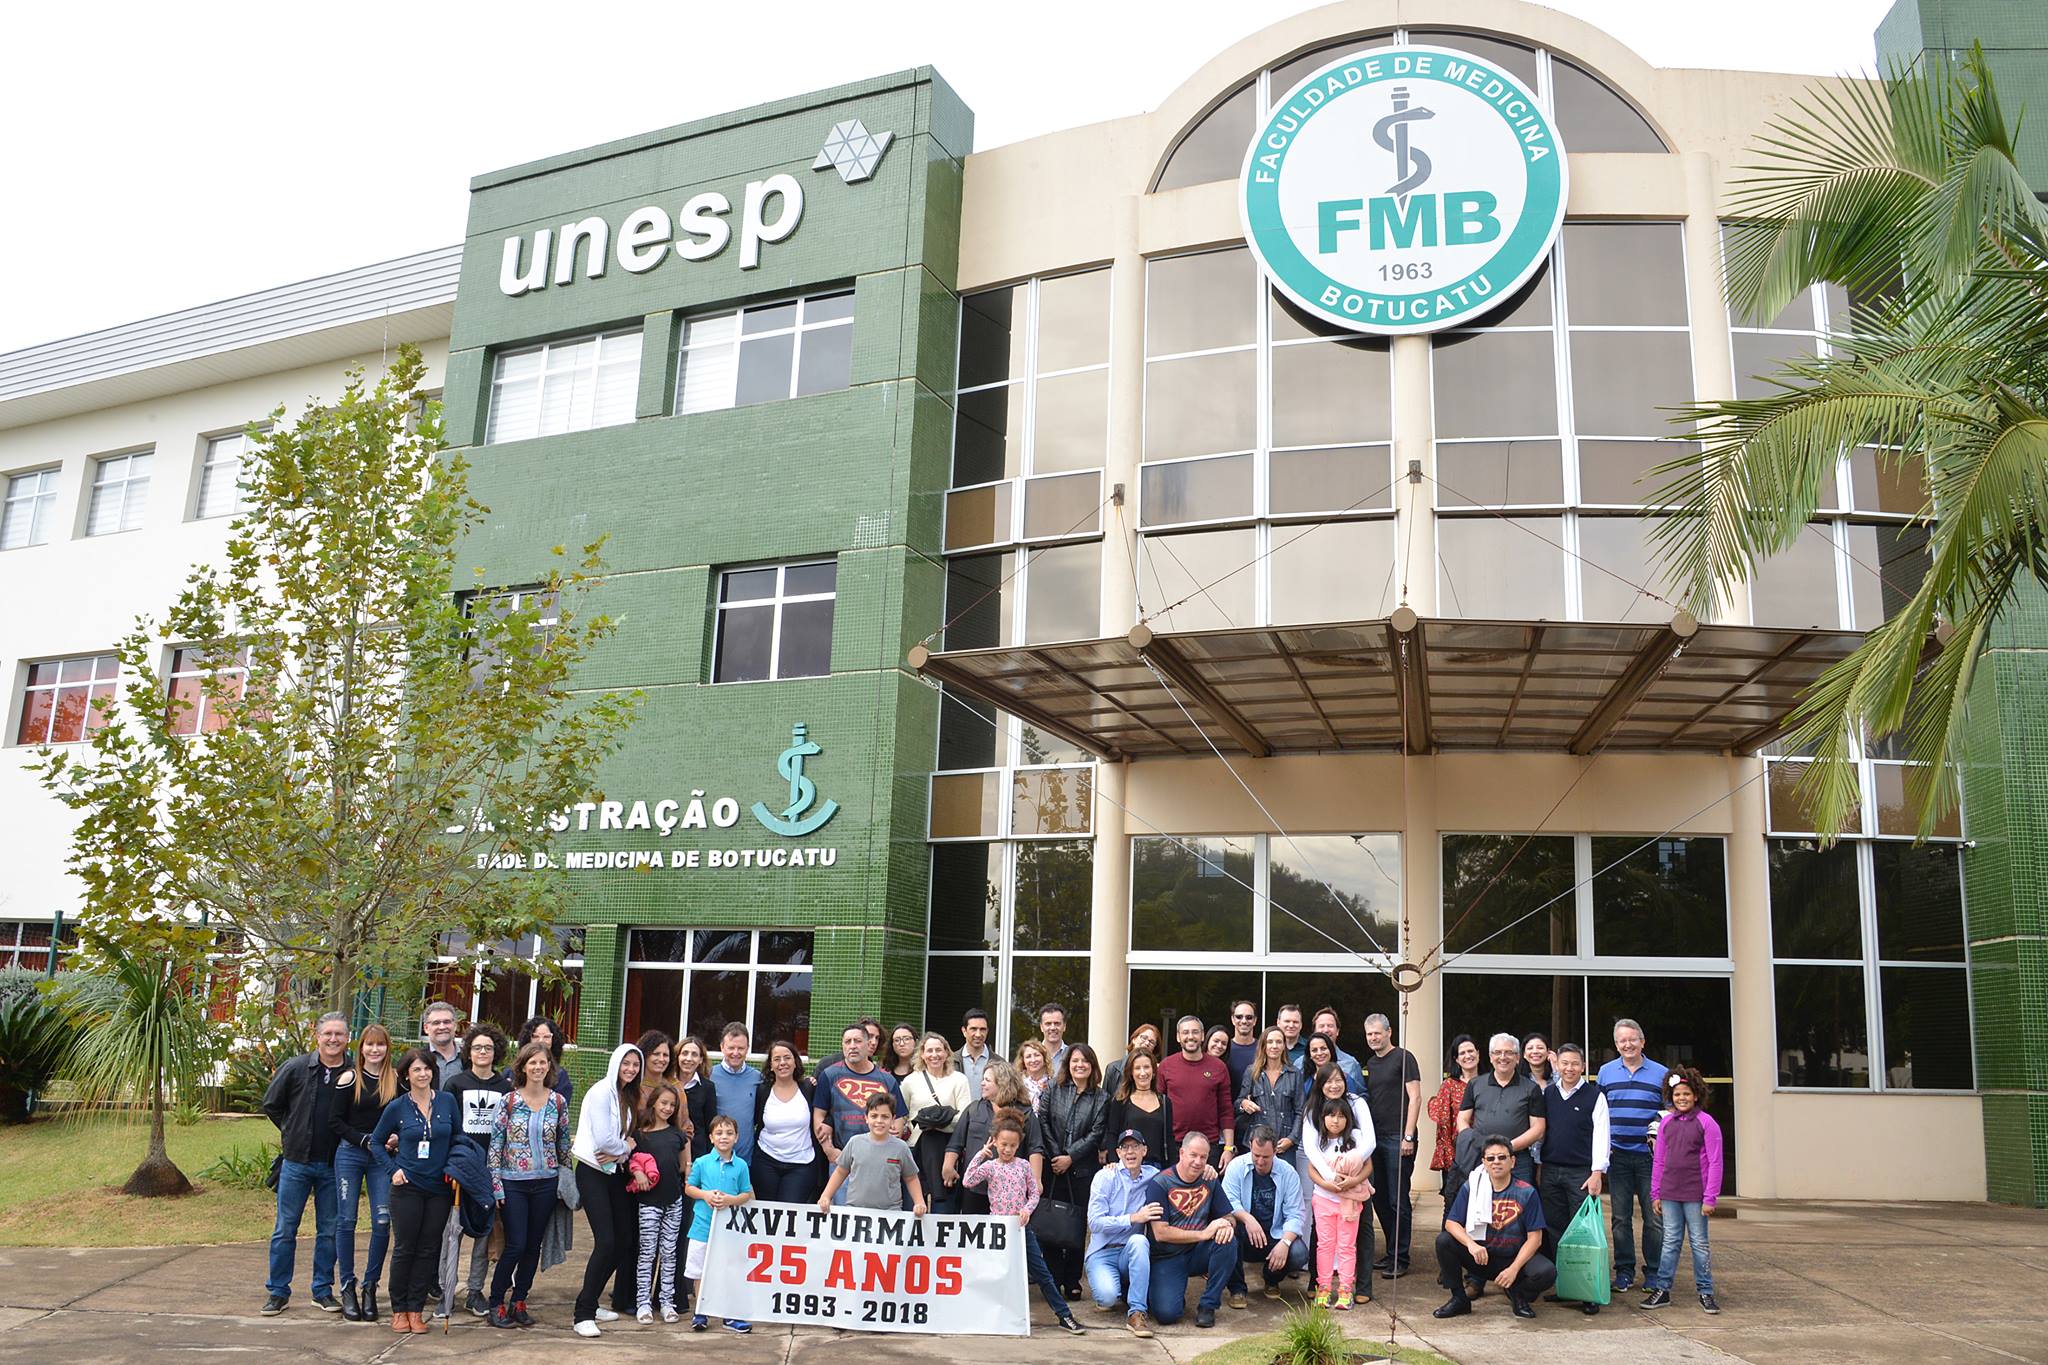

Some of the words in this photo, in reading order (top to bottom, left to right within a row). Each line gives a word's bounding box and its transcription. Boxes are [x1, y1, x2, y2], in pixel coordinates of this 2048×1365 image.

[1256, 60, 1383, 183] FACULDADE
[1394, 57, 1433, 75] DE
[1443, 61, 1550, 163] MEDICINA
[499, 173, 805, 298] unesp
[1318, 190, 1501, 254] FMB
[1378, 262, 1433, 281] 1963
[1319, 274, 1493, 320] BOTUCATU
[565, 851, 665, 870] MEDICINA
[672, 851, 700, 868] DE
[708, 848, 838, 868] BOTUCATU
[725, 1205, 798, 1238] XXVI
[806, 1211, 925, 1247] TURMA
[935, 1221, 1006, 1250] FMB
[746, 1243, 808, 1285] 25
[824, 1249, 963, 1295] ANOS
[771, 1292, 837, 1318] 1993
[862, 1300, 929, 1324] 2018
